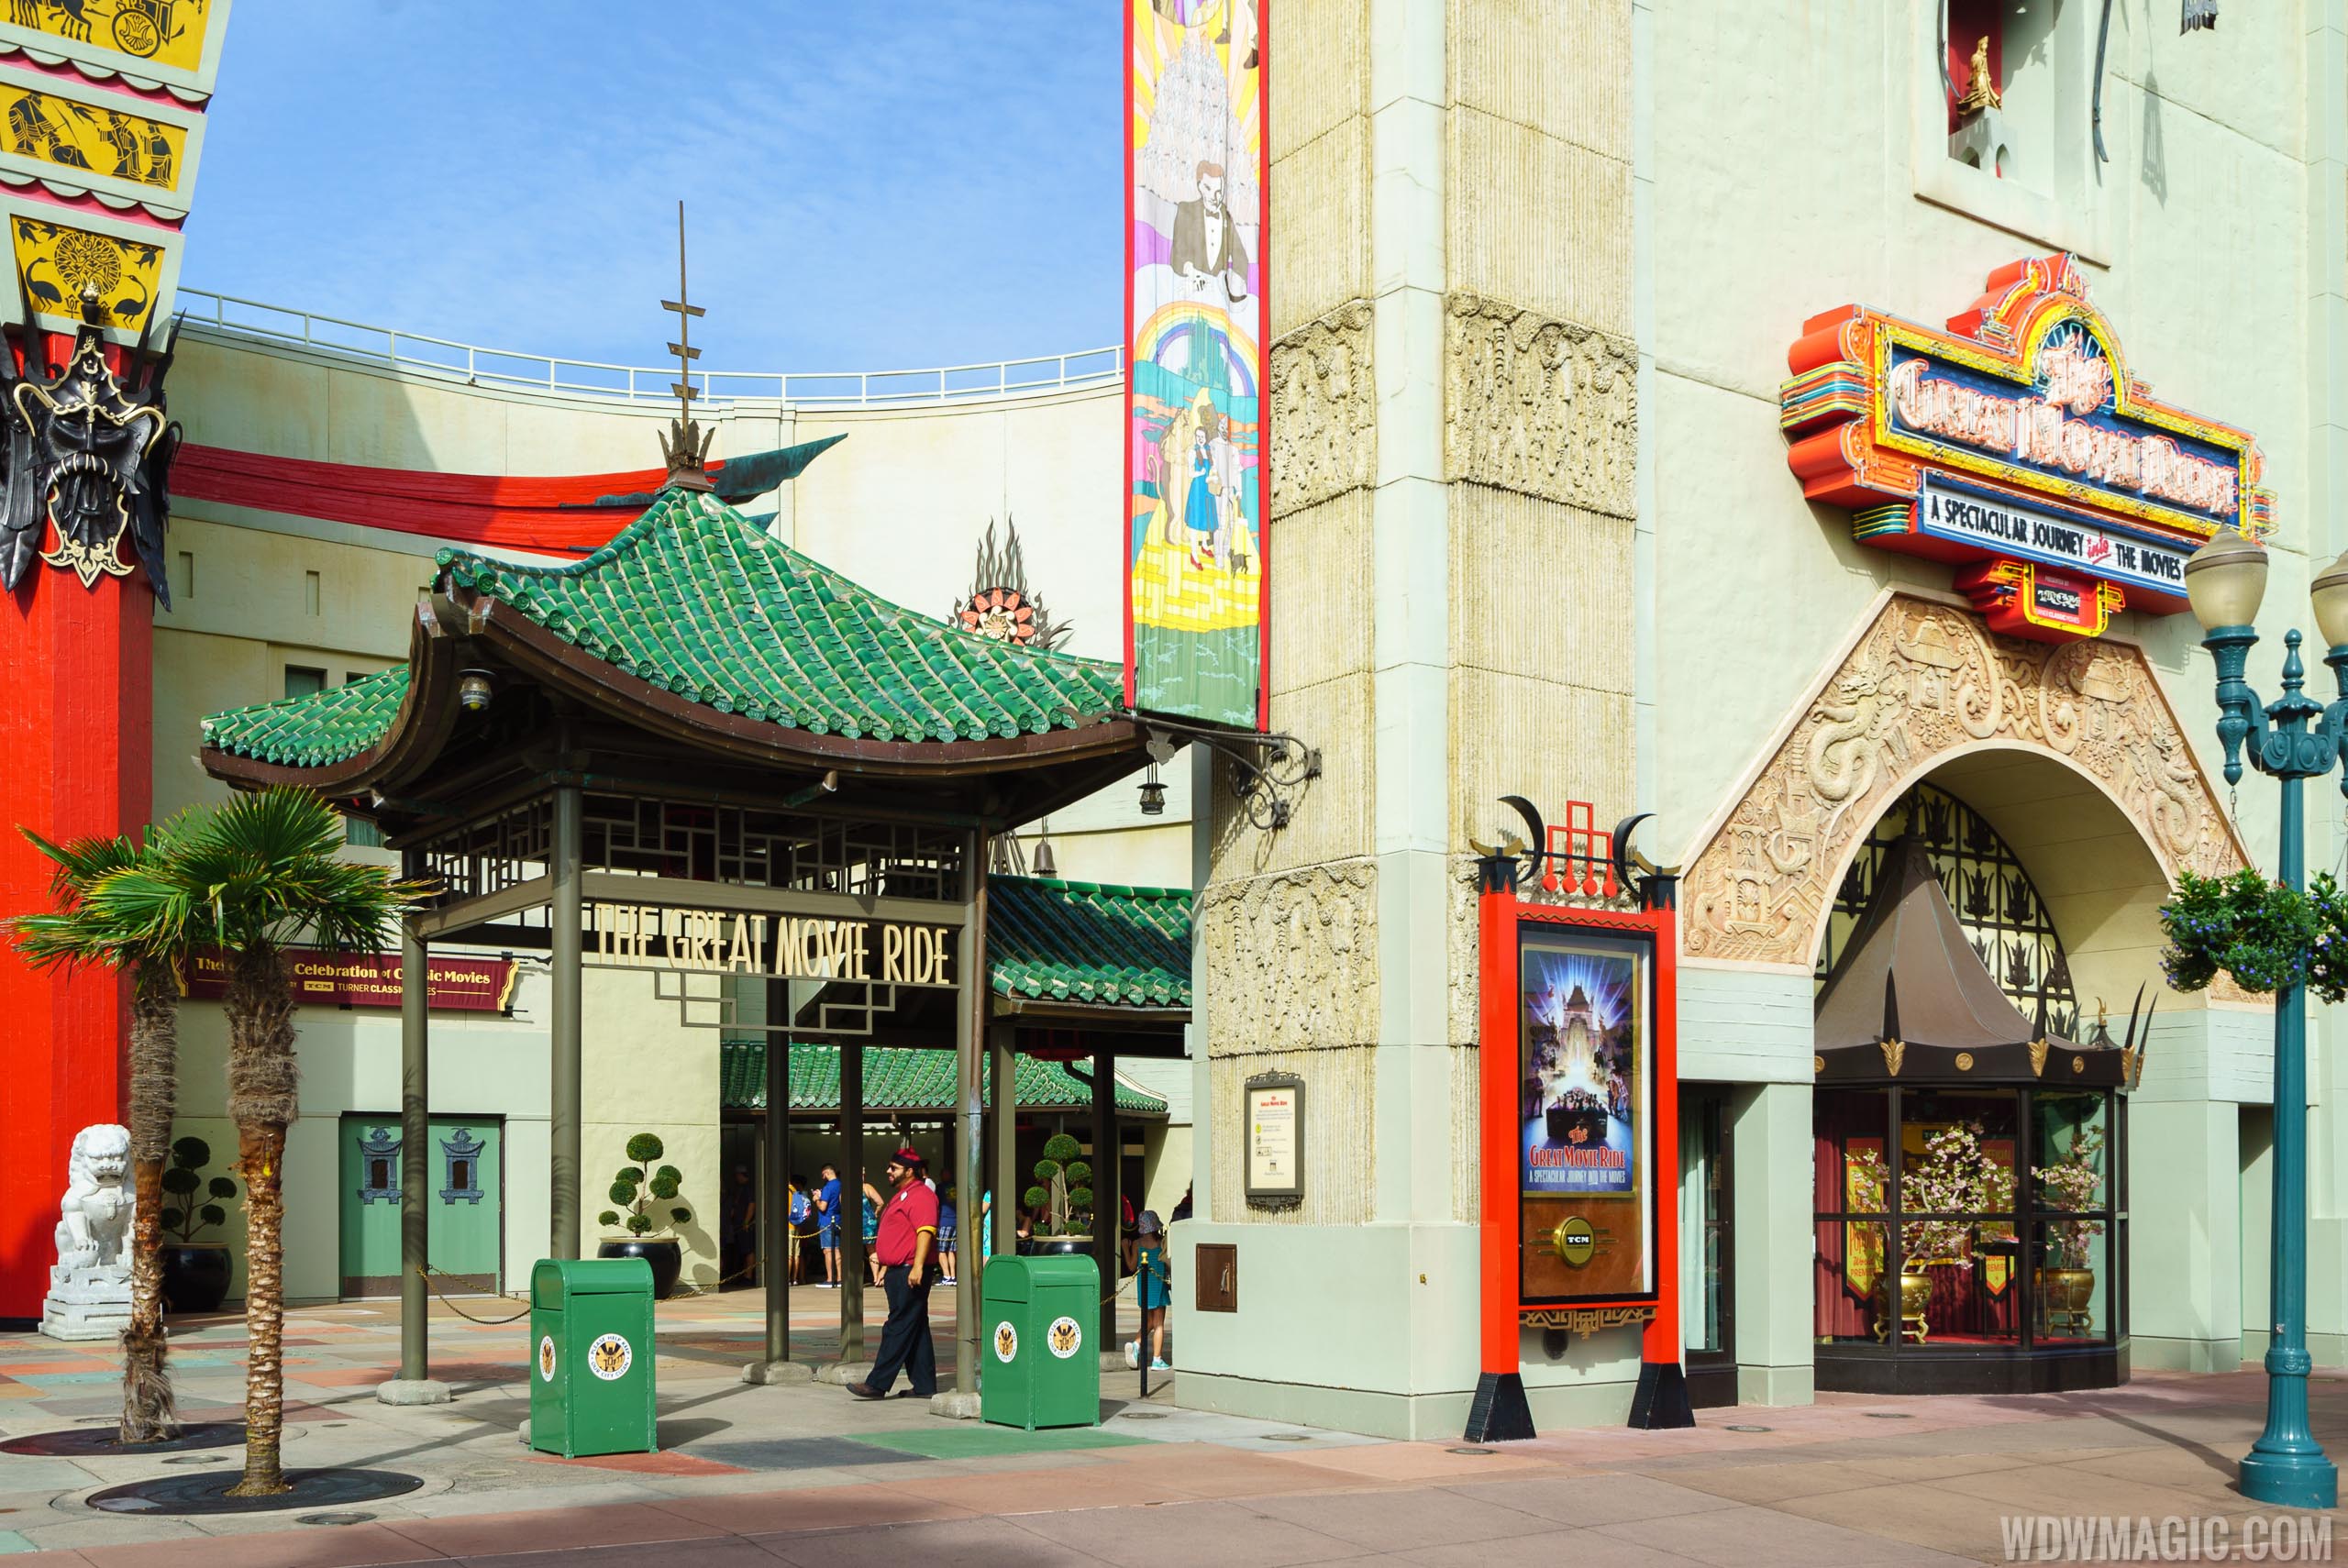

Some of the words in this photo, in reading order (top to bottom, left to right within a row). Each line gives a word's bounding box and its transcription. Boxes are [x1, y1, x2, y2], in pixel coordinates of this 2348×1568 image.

[2018, 395, 2143, 491] MOVIE
[2142, 435, 2239, 516] RIDE
[1931, 495, 1940, 520] A
[1944, 499, 2027, 543] SPECTACULAR
[2032, 521, 2084, 557] JOURNEY
[2087, 531, 2111, 565] into
[2115, 543, 2136, 569] THE
[2141, 549, 2181, 580] MOVIES
[2038, 590, 2080, 609] TCM
[594, 902, 659, 966] THE
[666, 908, 767, 974] GREAT
[775, 917, 870, 979] MOVIE
[883, 924, 949, 985] RIDE
[294, 963, 377, 978] Celebration
[382, 968, 391, 978] of
[445, 971, 491, 984] Movies
[338, 983, 369, 992] TURNER
[371, 986, 404, 994] CLASSI
[1529, 1144, 1563, 1167] GREAT
[1564, 1145, 1599, 1167] MOVIE
[1600, 1146, 1625, 1168] RIDE
[1529, 1170, 1534, 1183] A
[1534, 1170, 1566, 1183] SPECTACULAR
